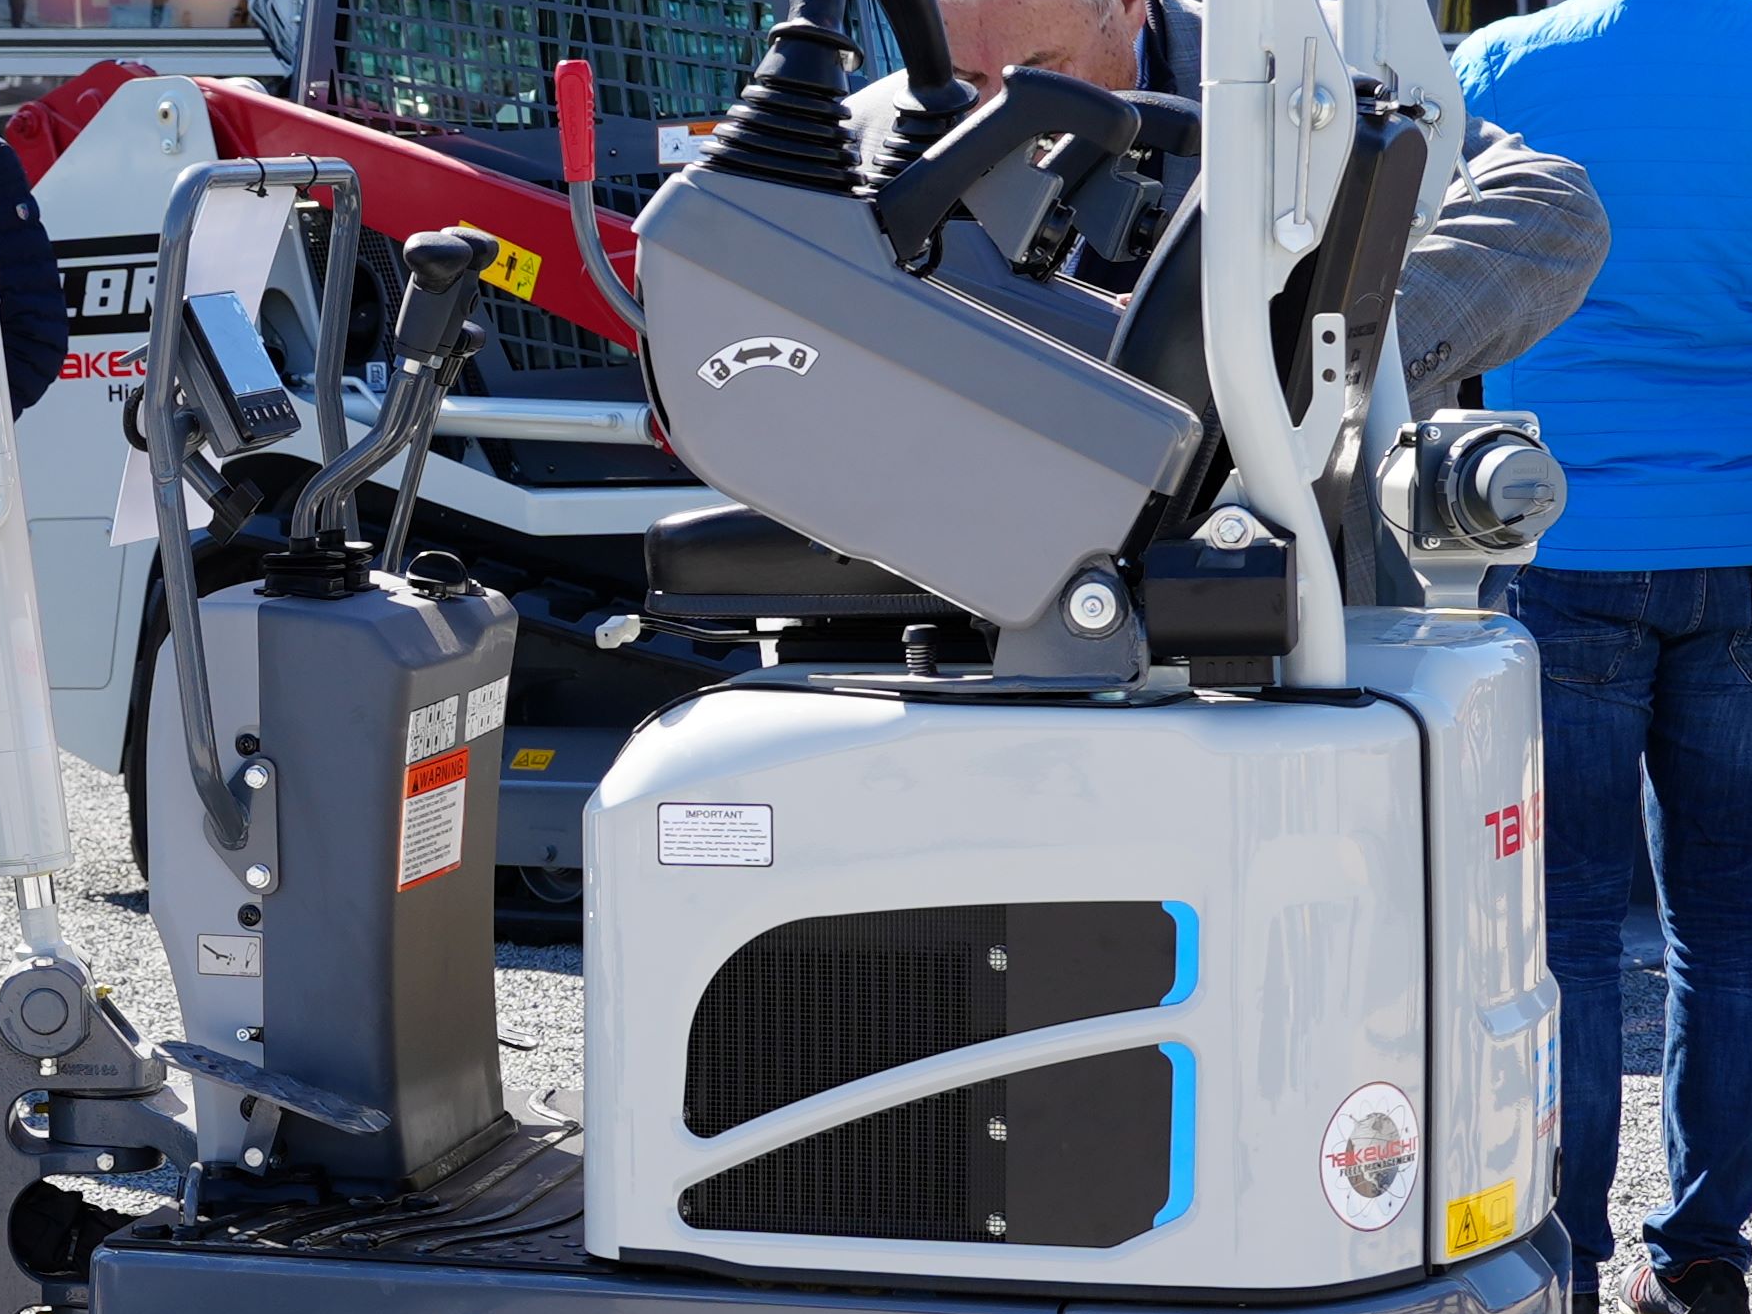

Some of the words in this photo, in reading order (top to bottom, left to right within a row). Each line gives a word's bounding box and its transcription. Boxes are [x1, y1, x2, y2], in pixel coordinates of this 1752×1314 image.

[418, 757, 464, 788] WARNING
[685, 810, 744, 819] IMPORTANT
[1325, 1135, 1418, 1169] TAKEUCHI
[1339, 1163, 1362, 1178] FLEET
[1364, 1152, 1416, 1173] MANAGEMENT
